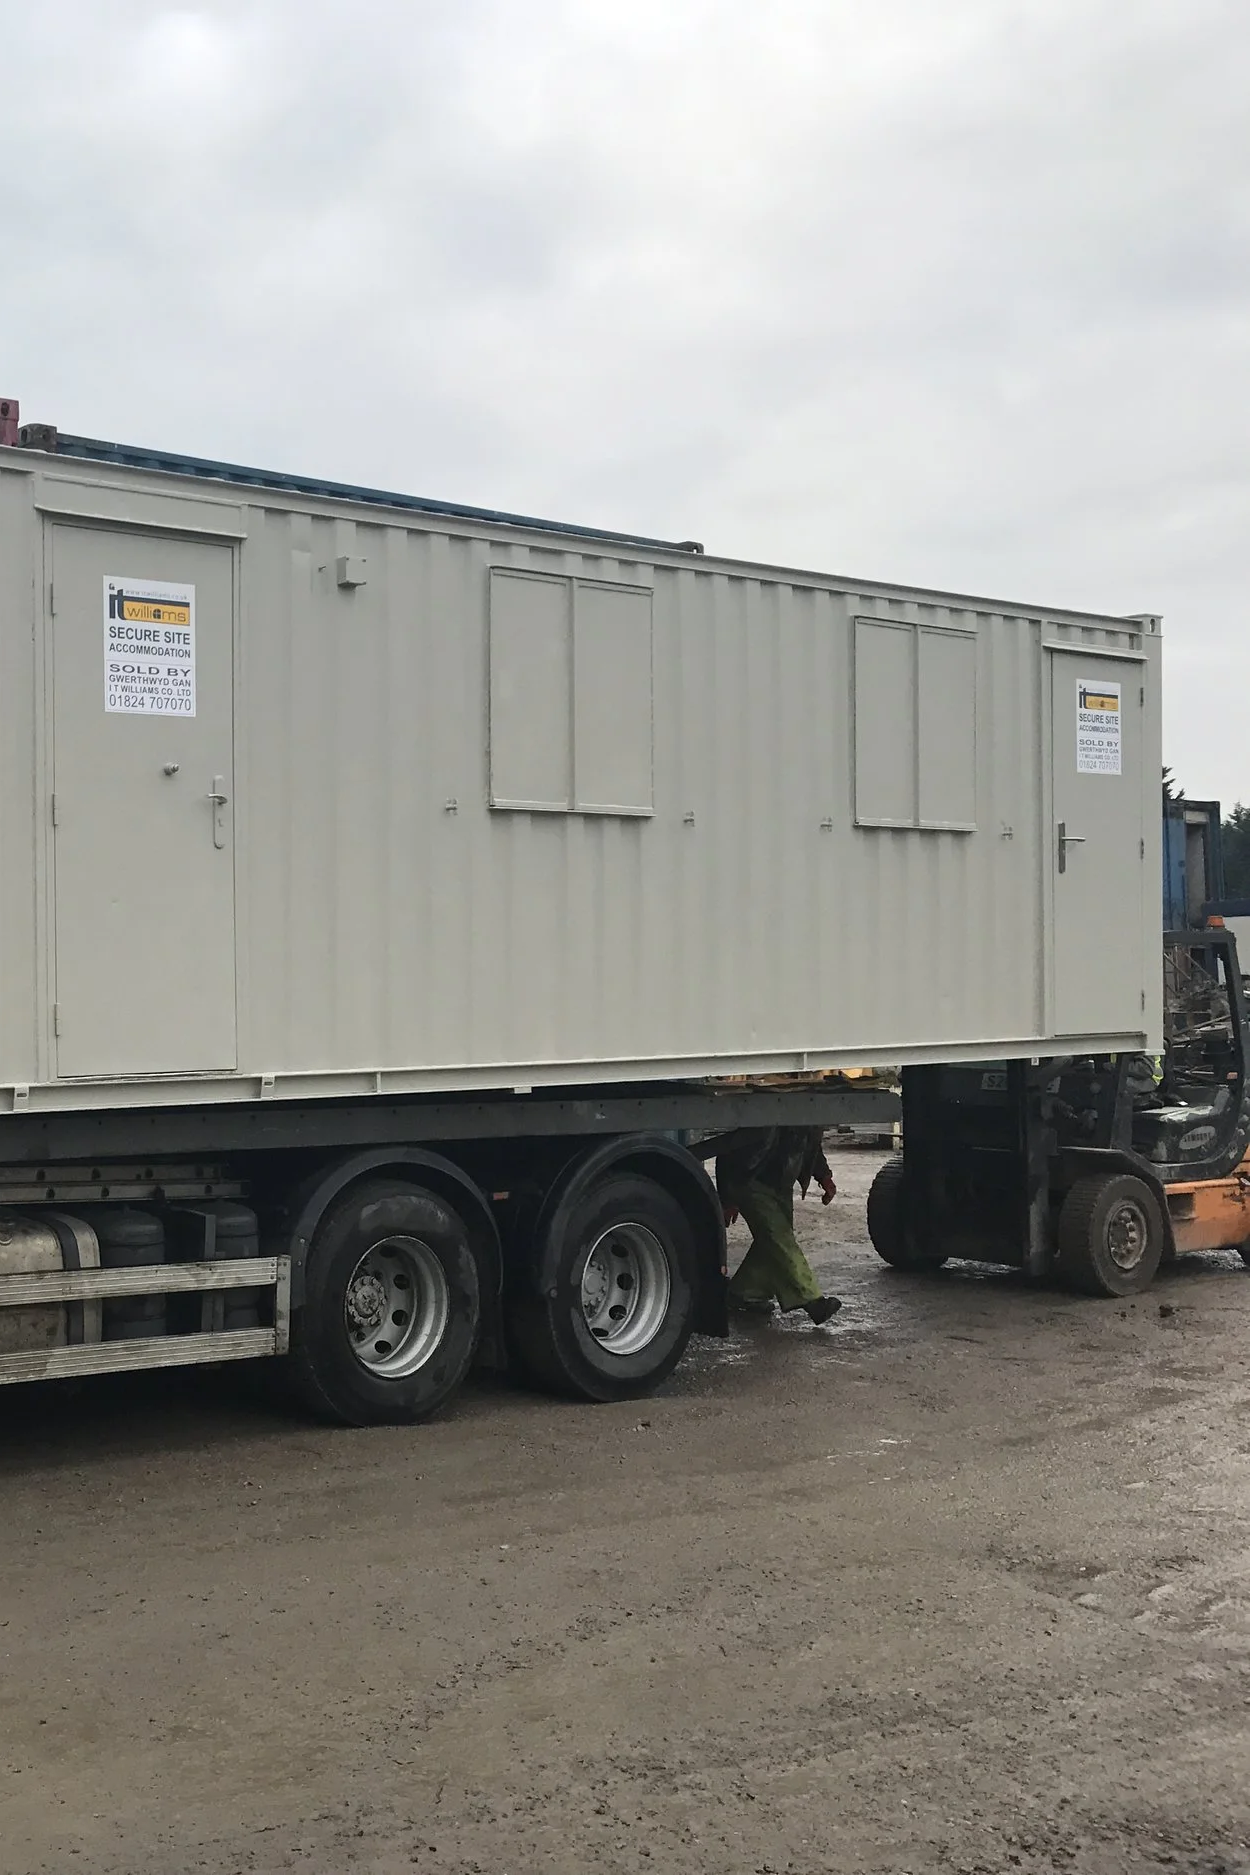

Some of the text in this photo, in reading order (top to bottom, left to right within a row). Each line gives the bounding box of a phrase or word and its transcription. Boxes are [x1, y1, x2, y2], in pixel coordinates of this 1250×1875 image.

[127, 606, 186, 622] williams
[109, 626, 191, 645] SECURE SITE
[109, 642, 191, 658] ACCOMMODATION
[109, 664, 191, 677] SOLD BY
[109, 675, 191, 687] GWERTHWYD GAN
[121, 685, 159, 695] WILLIAMS
[177, 689, 191, 697] LTD
[109, 694, 191, 711] 01824 707070
[1079, 713, 1119, 725] SECURE SITE
[1079, 739, 1104, 747] SOLD
